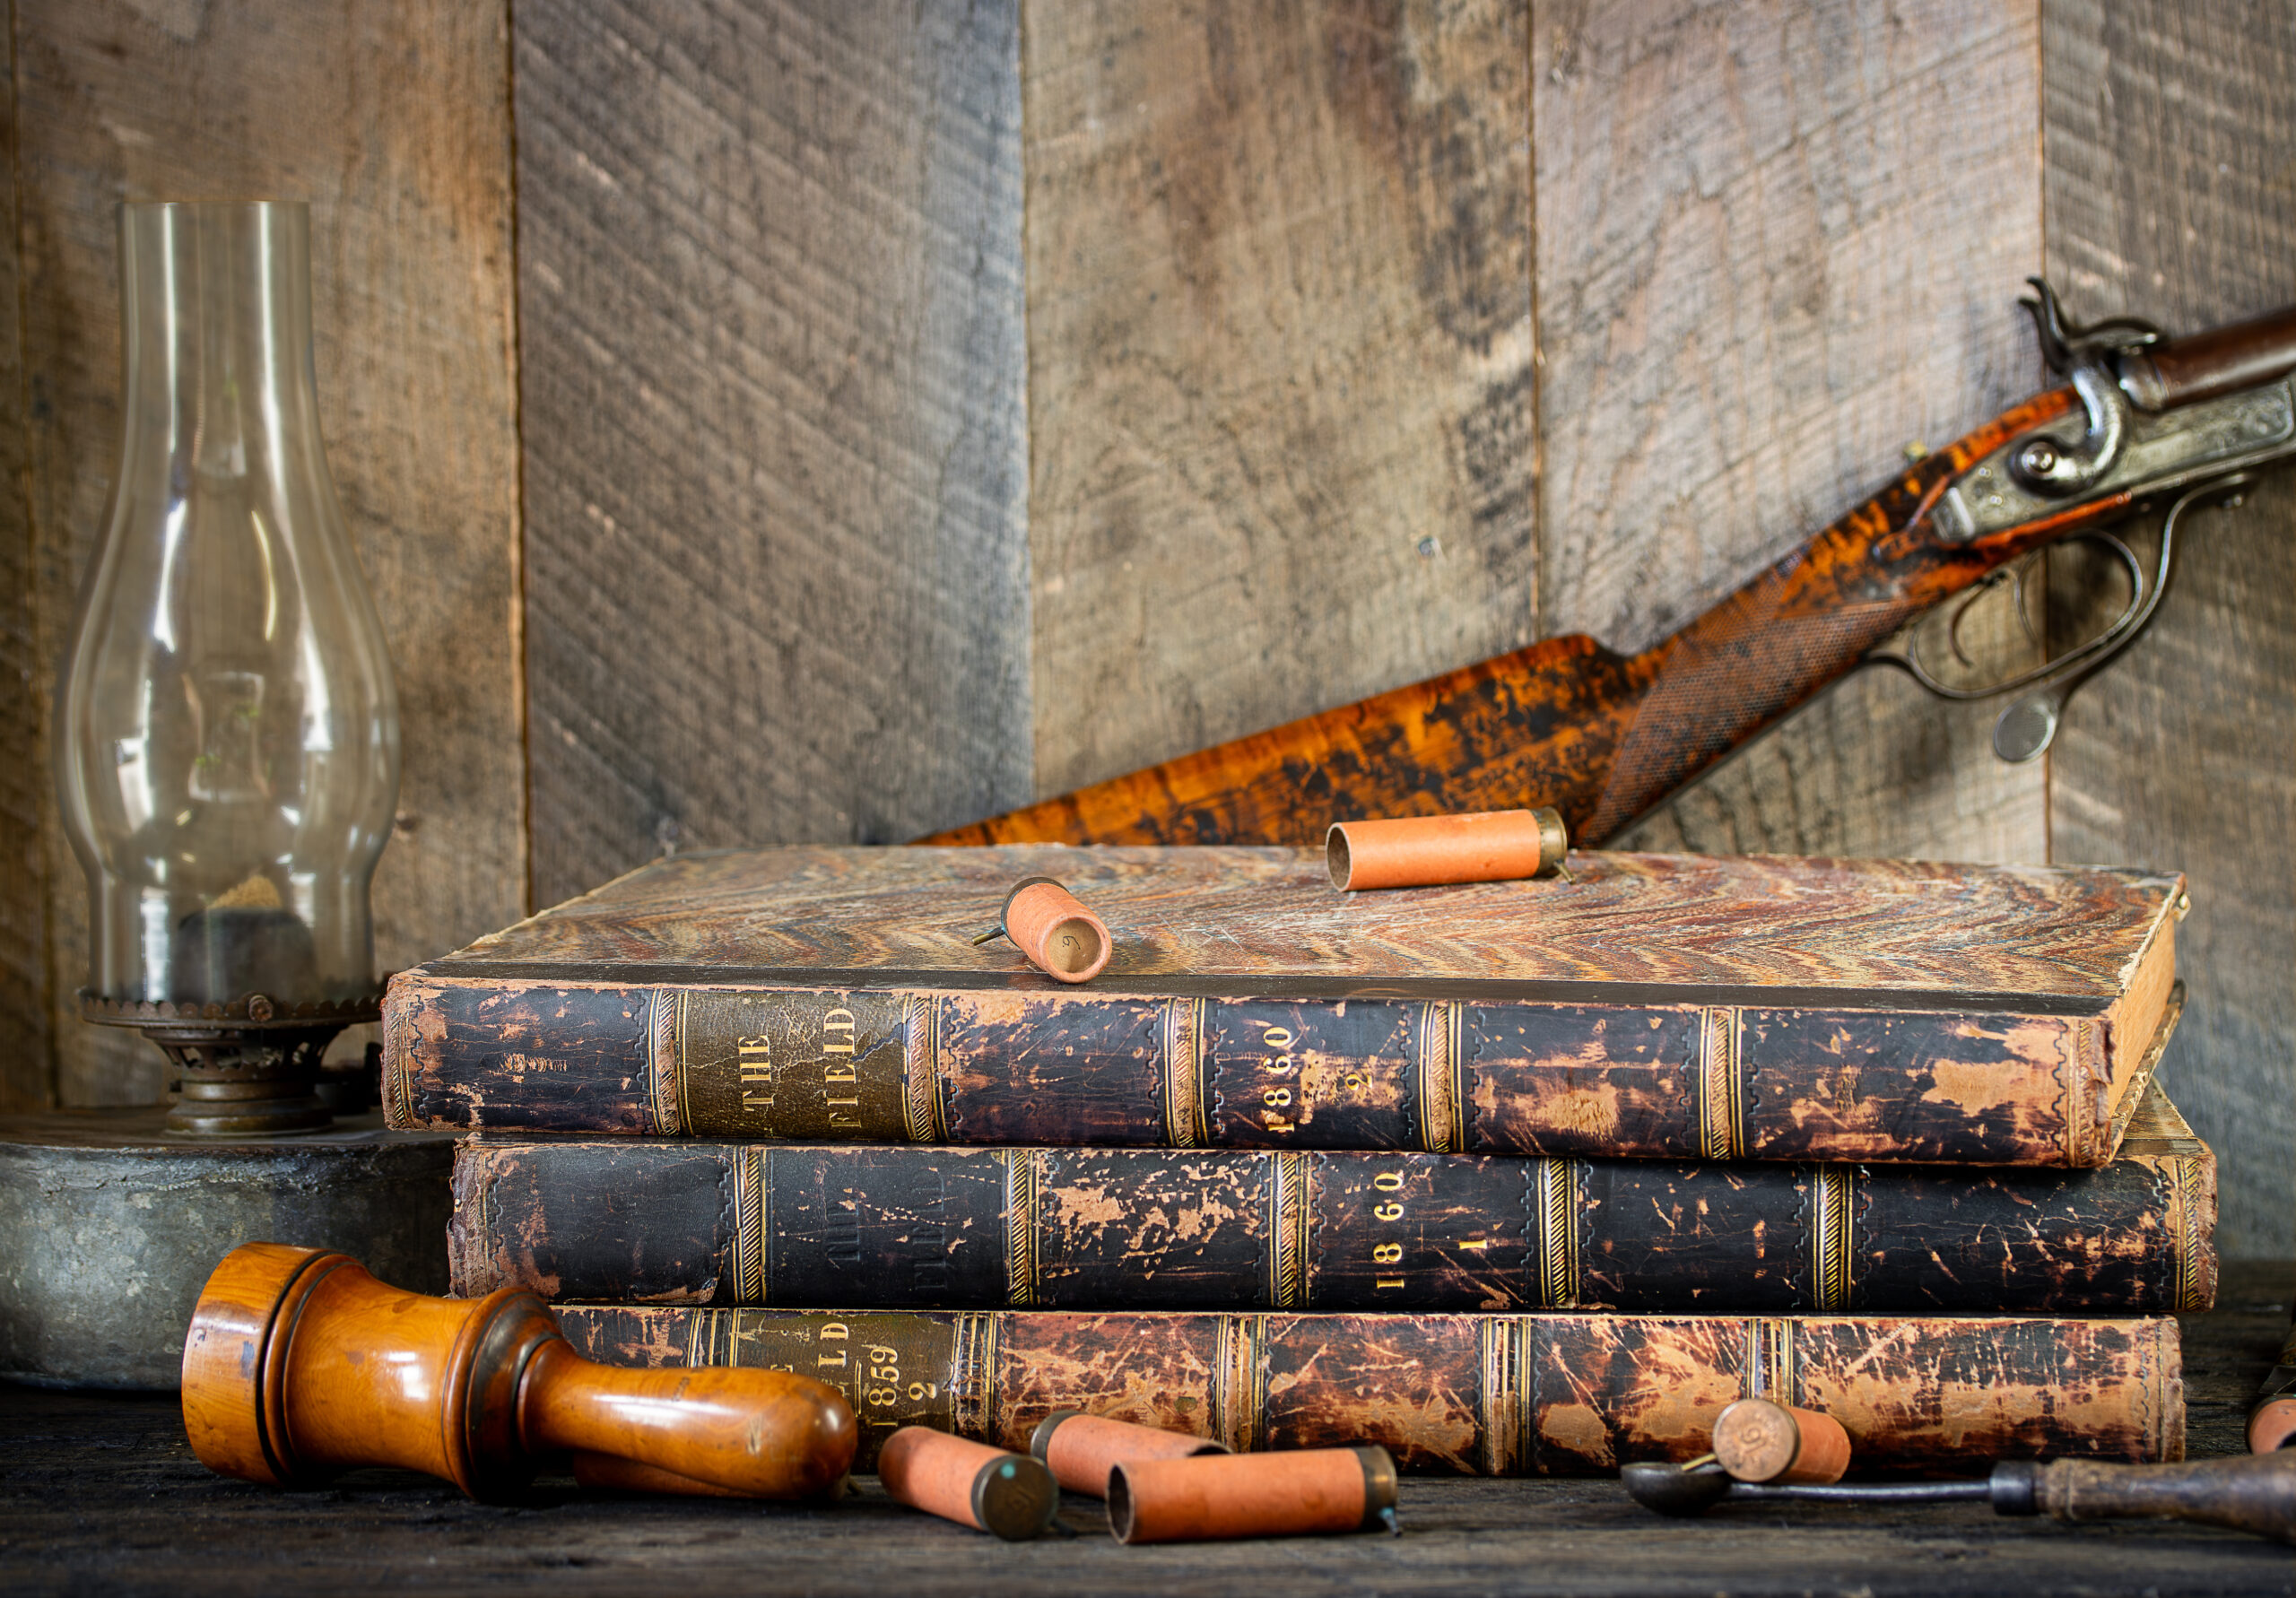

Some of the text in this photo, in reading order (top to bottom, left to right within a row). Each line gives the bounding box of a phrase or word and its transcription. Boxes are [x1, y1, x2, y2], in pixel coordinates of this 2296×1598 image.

[737, 1035, 774, 1112] THE
[823, 1008, 861, 1128] FIELD
[1263, 1027, 1295, 1132] 1860
[1345, 1073, 1373, 1090] 2
[1373, 1173, 1405, 1289] 1860
[867, 1346, 900, 1427] 1859
[908, 1382, 937, 1401] 2
